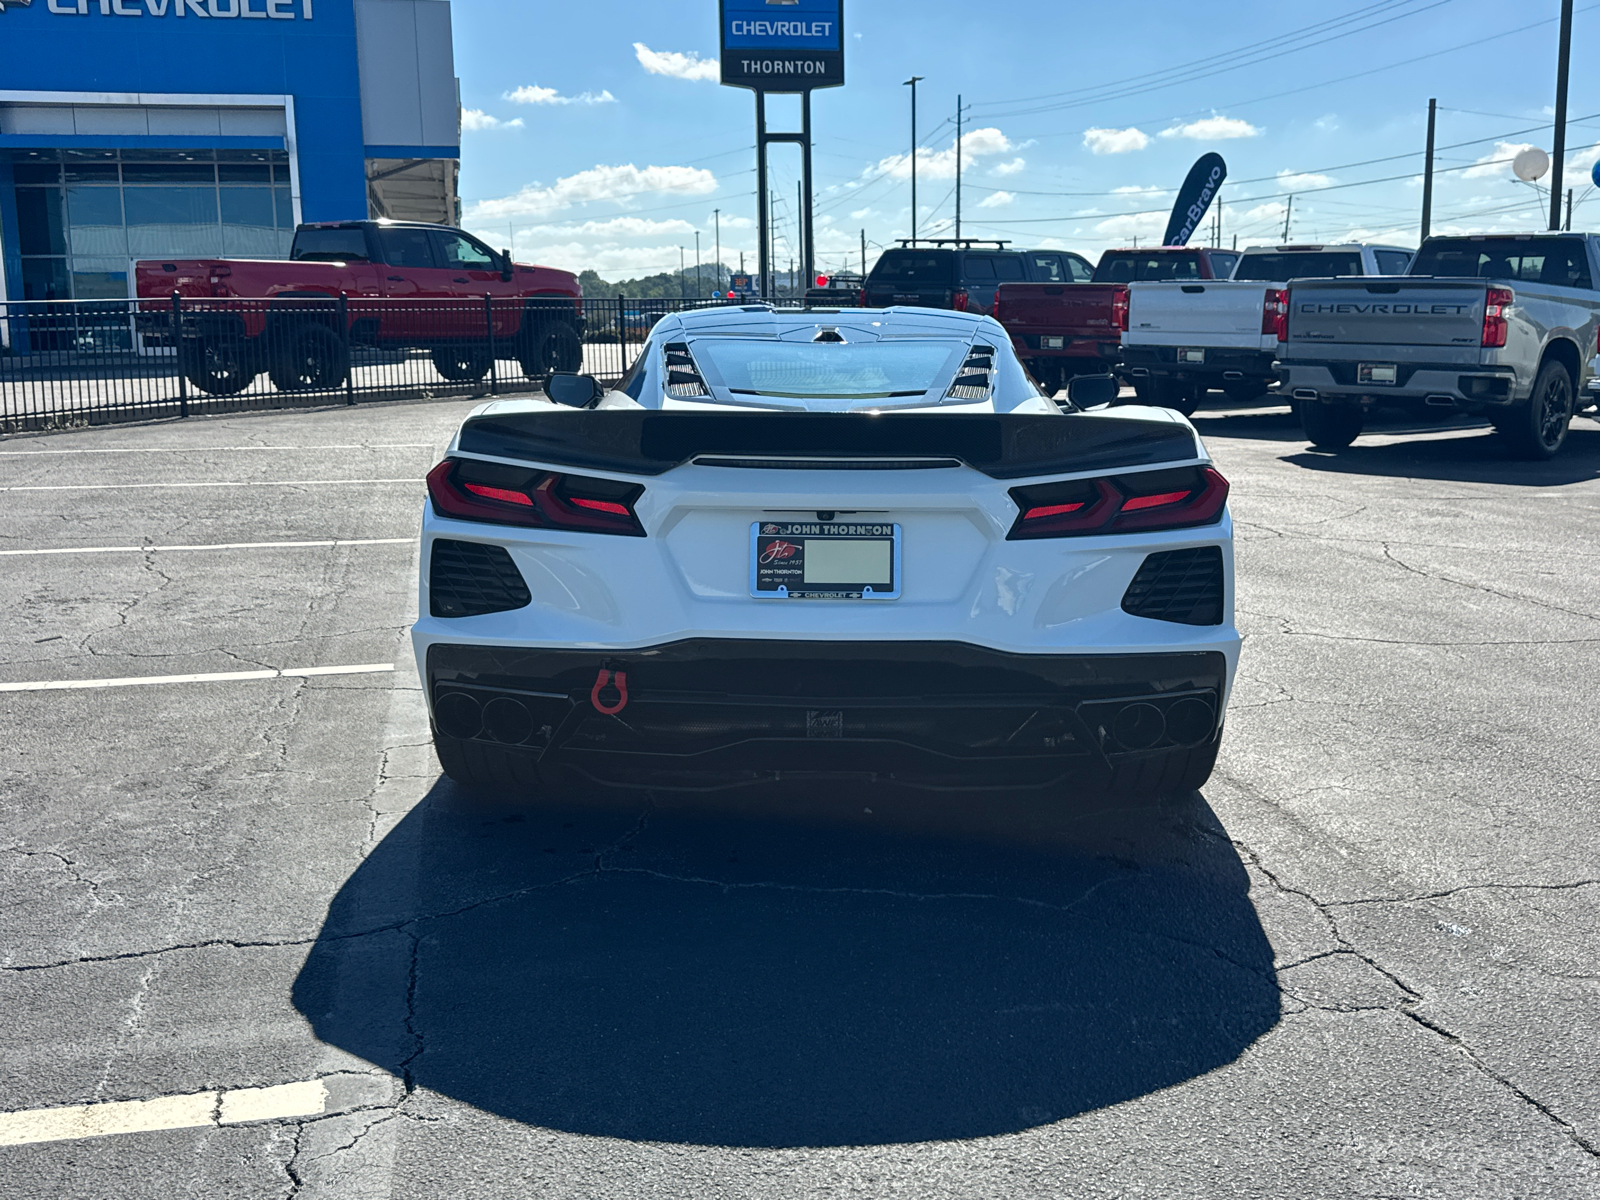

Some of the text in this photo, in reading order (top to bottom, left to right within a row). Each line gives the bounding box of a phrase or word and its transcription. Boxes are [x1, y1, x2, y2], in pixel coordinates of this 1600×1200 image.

[731, 20, 833, 36] CHEVROLET
[741, 60, 825, 74] THORNTON
[1301, 304, 1467, 315] CHEVROLET
[787, 525, 820, 534] JOHN
